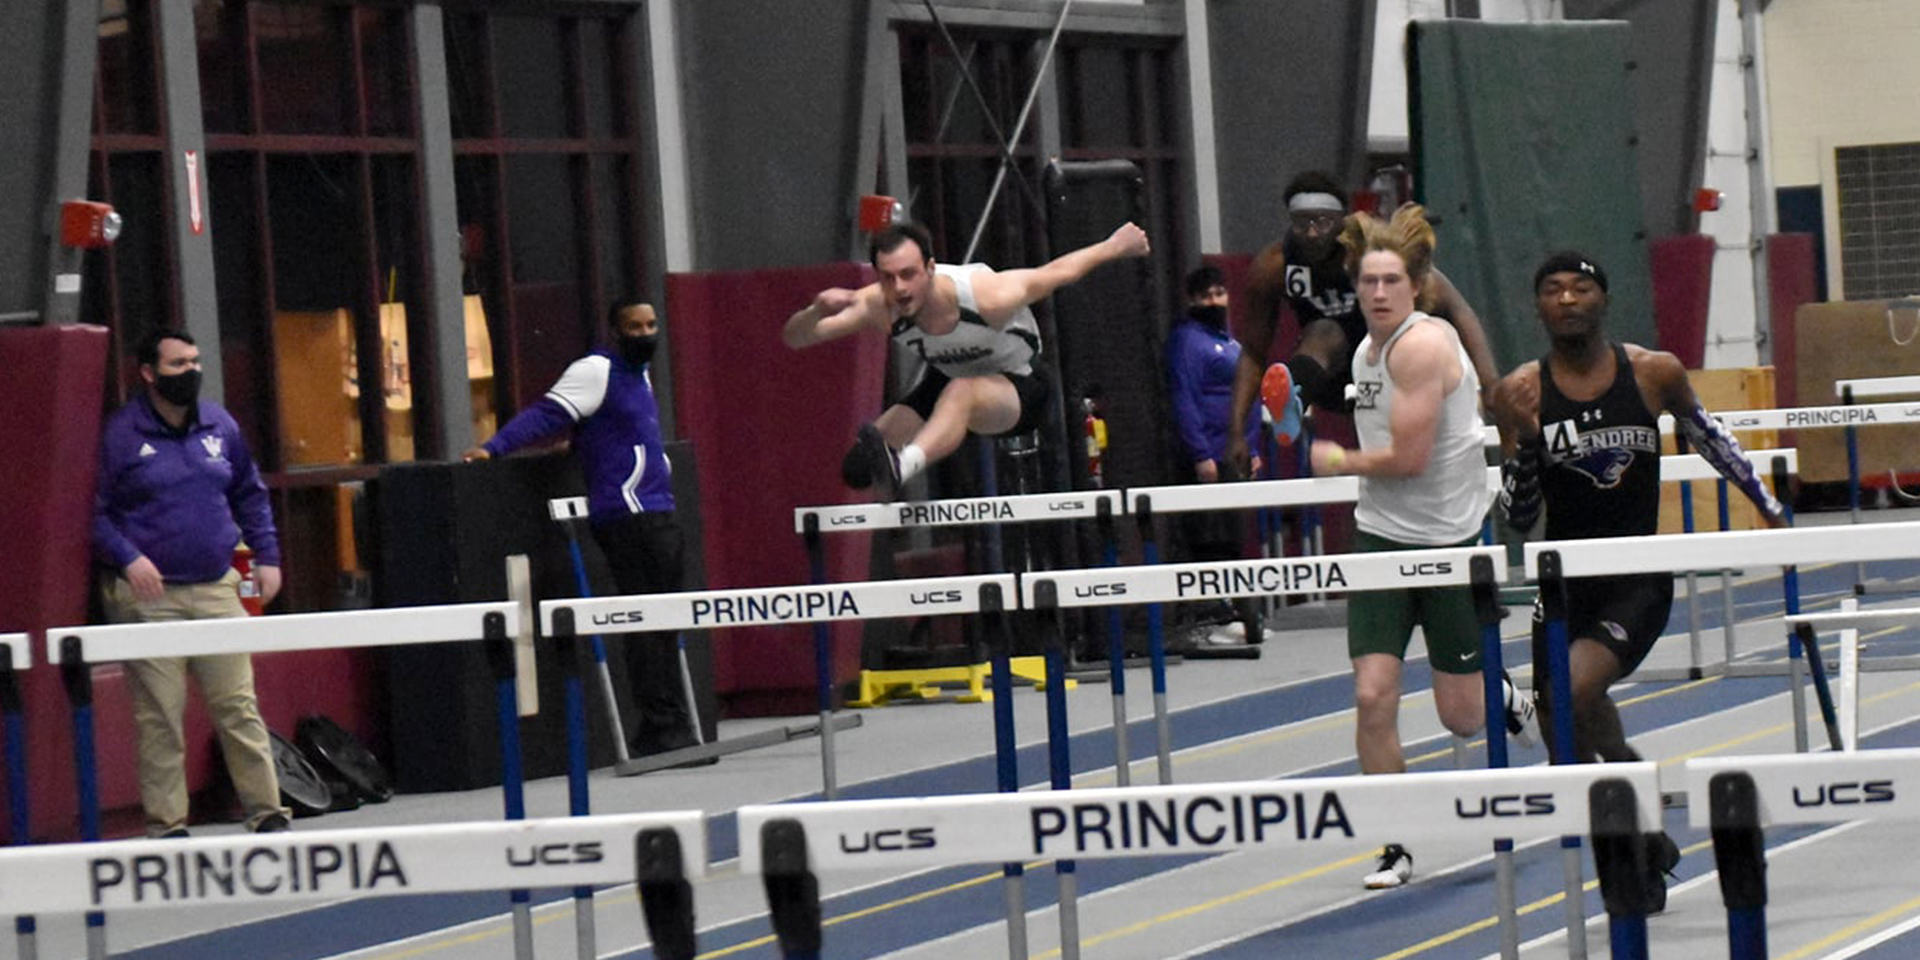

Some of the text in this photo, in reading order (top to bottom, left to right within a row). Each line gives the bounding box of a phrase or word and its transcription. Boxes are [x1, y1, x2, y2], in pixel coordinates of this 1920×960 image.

[1289, 267, 1306, 295] 6
[1733, 416, 1760, 426] UCS
[1786, 408, 1878, 425] PRINCIPIA
[1550, 422, 1582, 460] 4
[1578, 429, 1656, 450] ENDREE
[830, 501, 1085, 525] UCS PRINCIPIA UCS
[1075, 562, 1452, 598] UCS PRINCIPIA UCS
[592, 590, 962, 626] UCS PRINCIPIA UCS
[1792, 780, 1896, 807] UCS
[840, 790, 1555, 854] UCS PRINCIPIA UCS
[88, 840, 604, 904] PRINCIPIA UCS
